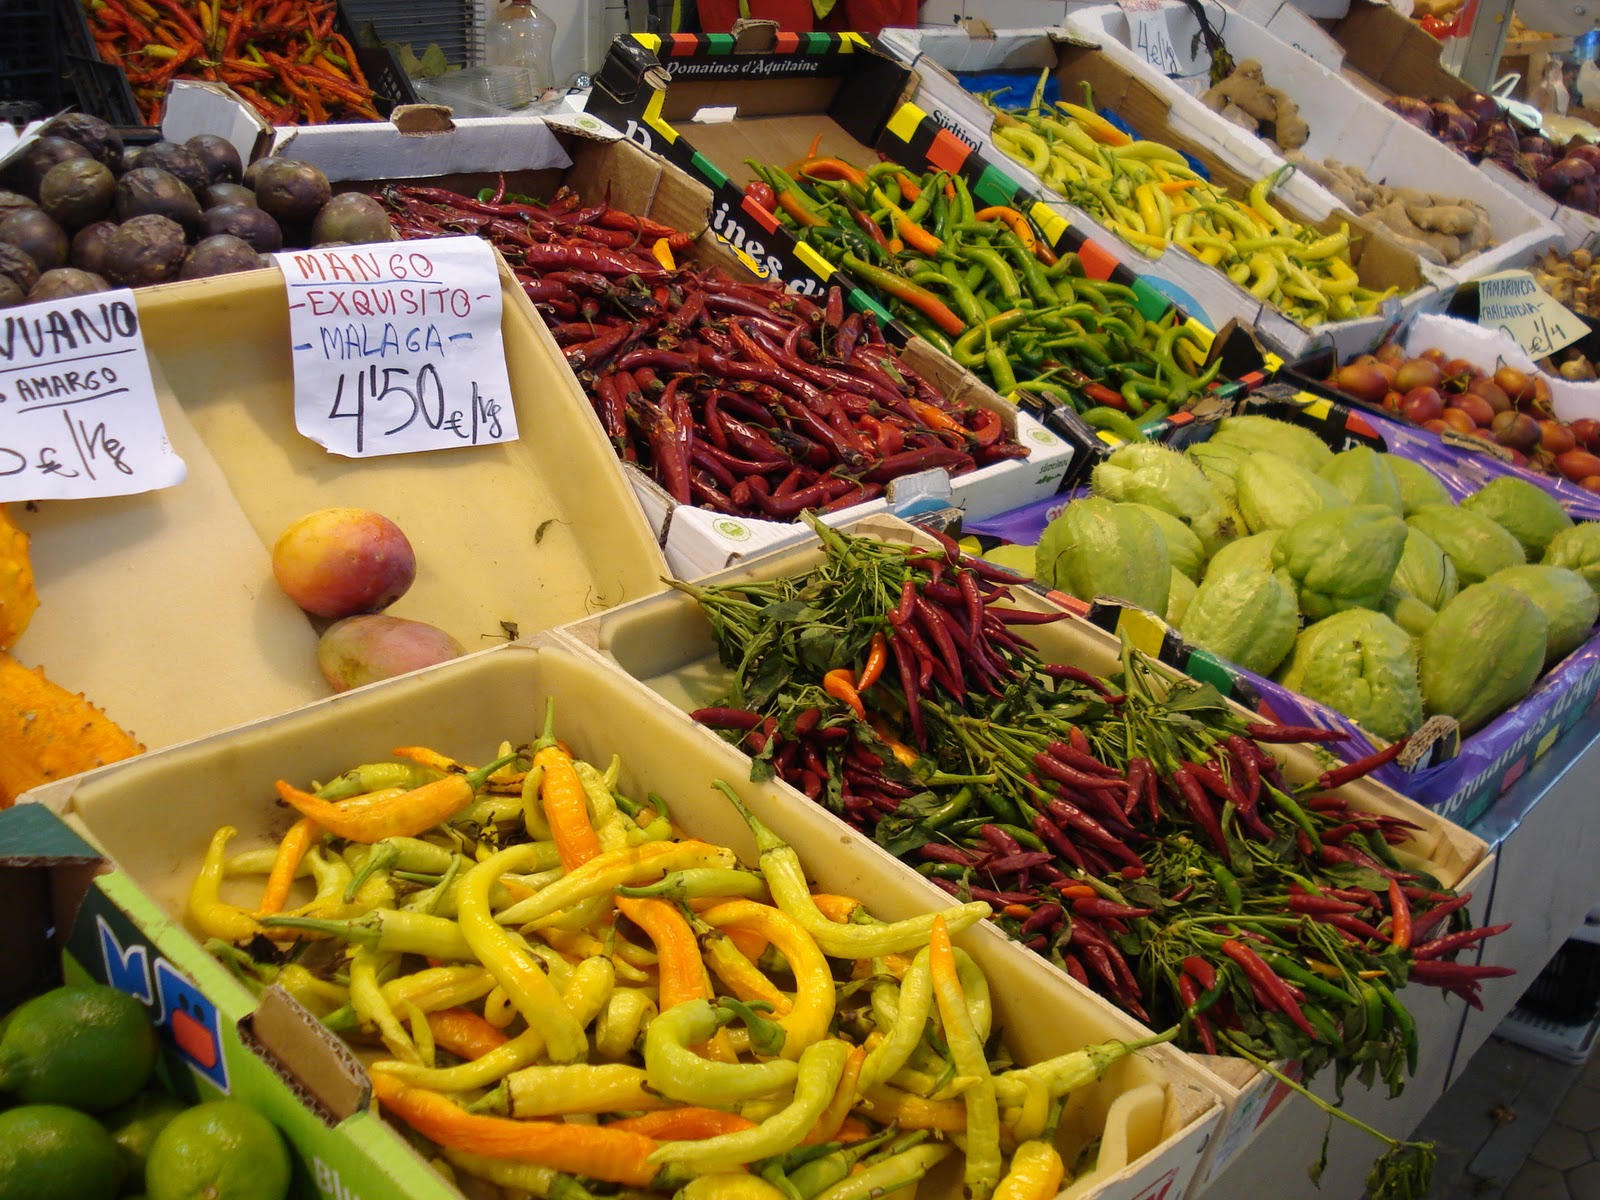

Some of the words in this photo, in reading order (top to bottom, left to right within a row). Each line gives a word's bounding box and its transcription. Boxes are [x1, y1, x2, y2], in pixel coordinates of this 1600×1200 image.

[666, 61, 739, 75] Domaines
[933, 109, 983, 154] Südtirol
[293, 252, 434, 282] MANGO
[15, 366, 118, 403] AMARGO
[312, 1155, 360, 1200] Bl
